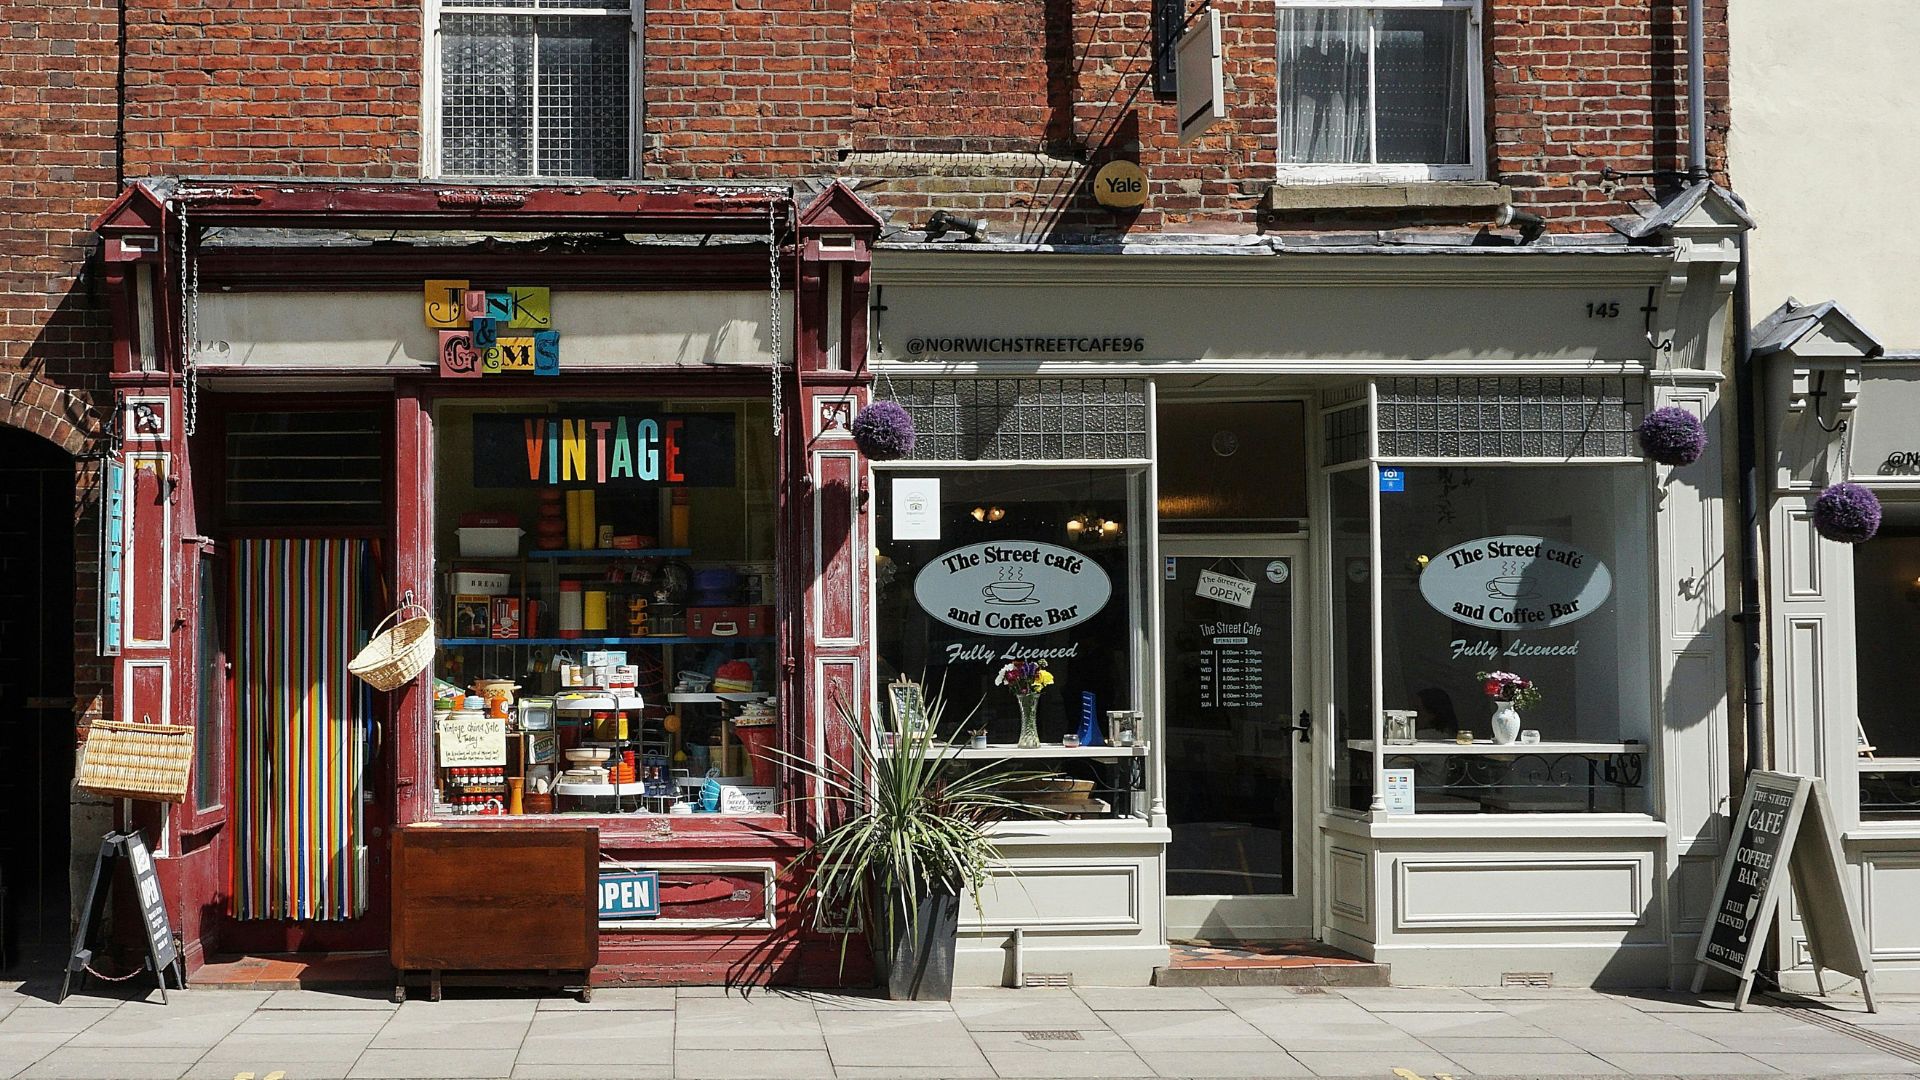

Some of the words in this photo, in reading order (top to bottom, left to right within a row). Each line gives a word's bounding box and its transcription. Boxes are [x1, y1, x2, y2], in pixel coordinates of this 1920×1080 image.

[1105, 177, 1142, 193] Yale
[1586, 303, 1620, 318] 145
[475, 319, 497, 345] &
[906, 337, 1145, 354] @NORWICHSTREETCAFE96
[524, 416, 684, 484] VINTAGE
[1888, 451, 1920, 467] @N
[942, 551, 979, 575] The
[984, 546, 1040, 564] Street
[1044, 553, 1084, 575] café
[1446, 547, 1484, 570] The
[1487, 541, 1543, 559] Street
[1546, 548, 1585, 570] café
[1201, 576, 1216, 584] The
[1217, 577, 1237, 587] Street
[1209, 586, 1242, 602] OPEN
[948, 606, 981, 627] and
[985, 613, 1044, 630] Coffee
[1045, 604, 1078, 625] Bar
[1452, 599, 1484, 621] and
[1489, 606, 1546, 624] Coffee
[1550, 599, 1580, 619] Bar
[1200, 623, 1216, 637] The
[1216, 621, 1241, 634] Street
[1243, 621, 1262, 636] Cafe
[946, 643, 997, 665] Fully
[1001, 642, 1079, 660] Licenced
[1450, 639, 1499, 660] Fully
[1503, 638, 1579, 657] Licenced
[1754, 790, 1768, 802] THE
[1767, 793, 1793, 807] STREET
[1748, 809, 1785, 835] CAFÉ
[1753, 836, 1766, 844] AND
[1737, 847, 1773, 870] COFFEE
[1737, 867, 1759, 887] BAR
[1726, 899, 1745, 914] FULLY
[1717, 912, 1745, 930] LICENCED
[1708, 942, 1726, 956] OPEN
[1724, 949, 1731, 959] 7
[1729, 950, 1745, 964] DAYS
